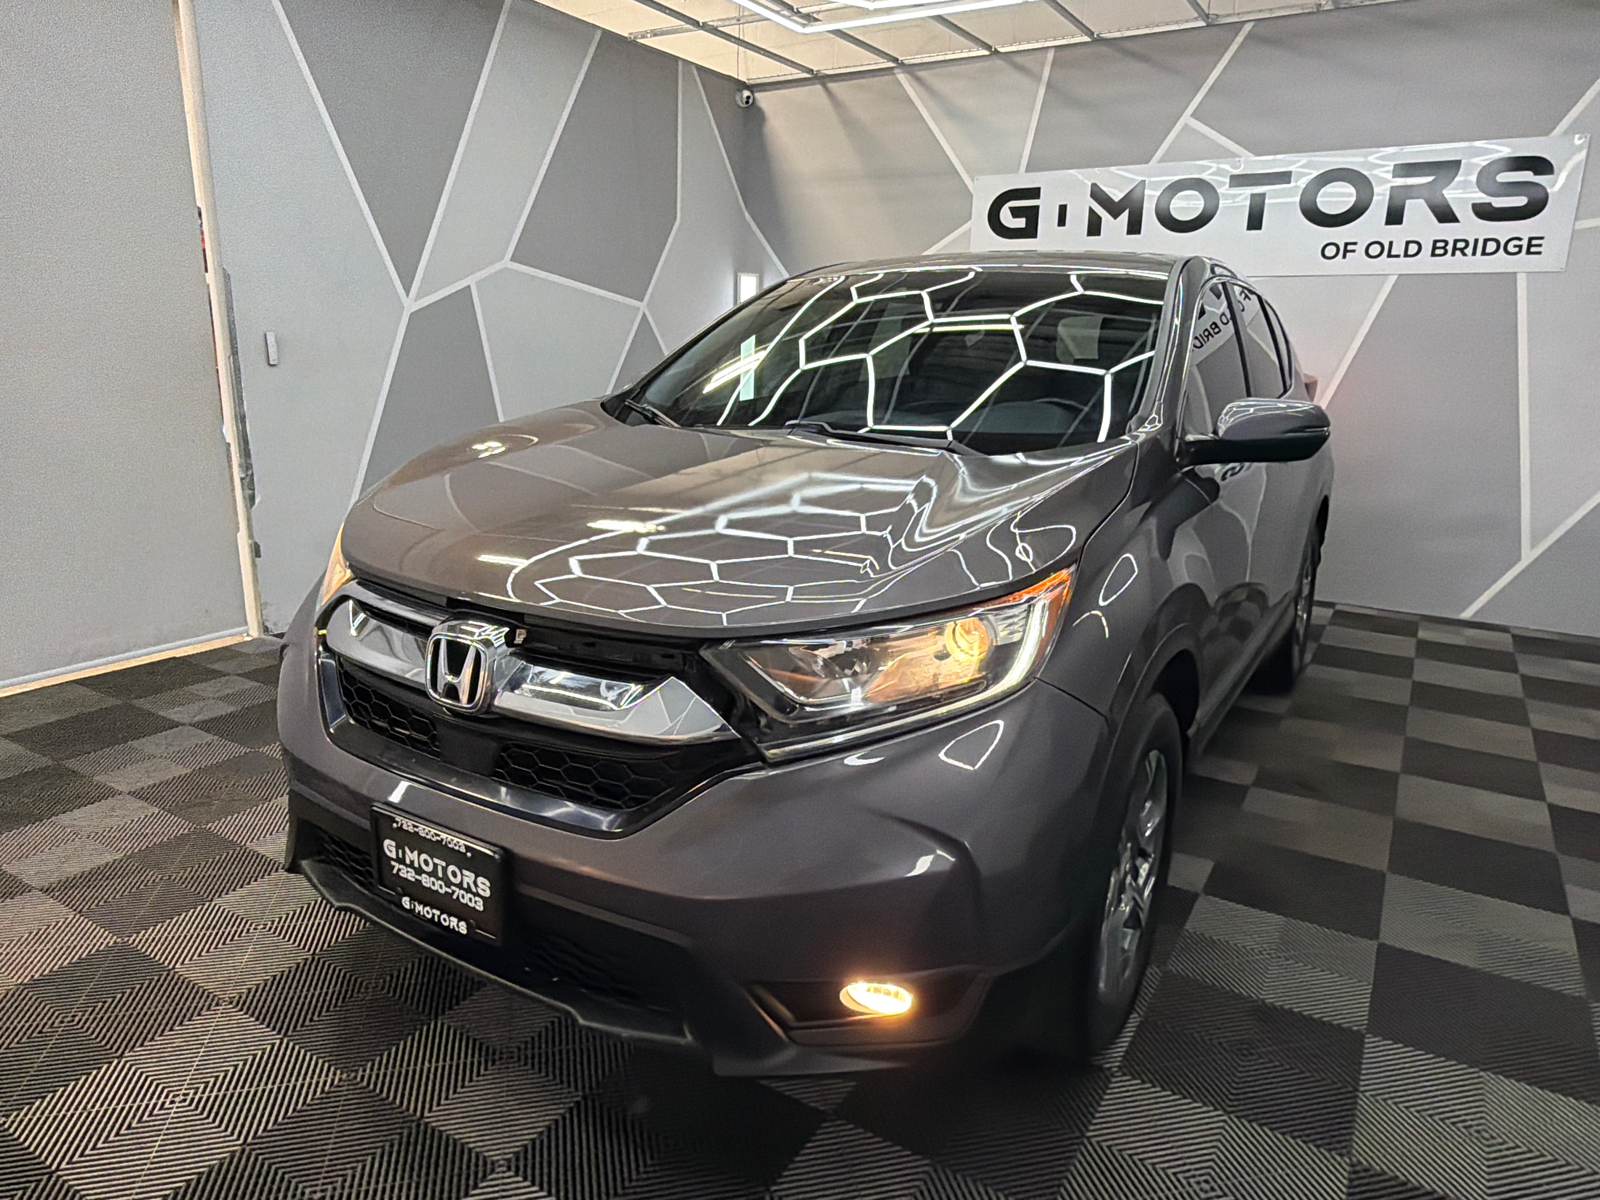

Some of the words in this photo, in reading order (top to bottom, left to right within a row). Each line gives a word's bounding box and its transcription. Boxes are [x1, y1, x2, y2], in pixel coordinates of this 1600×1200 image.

[1320, 241, 1358, 260] OF
[1364, 240, 1423, 259] OLD
[1430, 236, 1545, 258] BRIDGE
[391, 861, 484, 912] 732-800-7003
